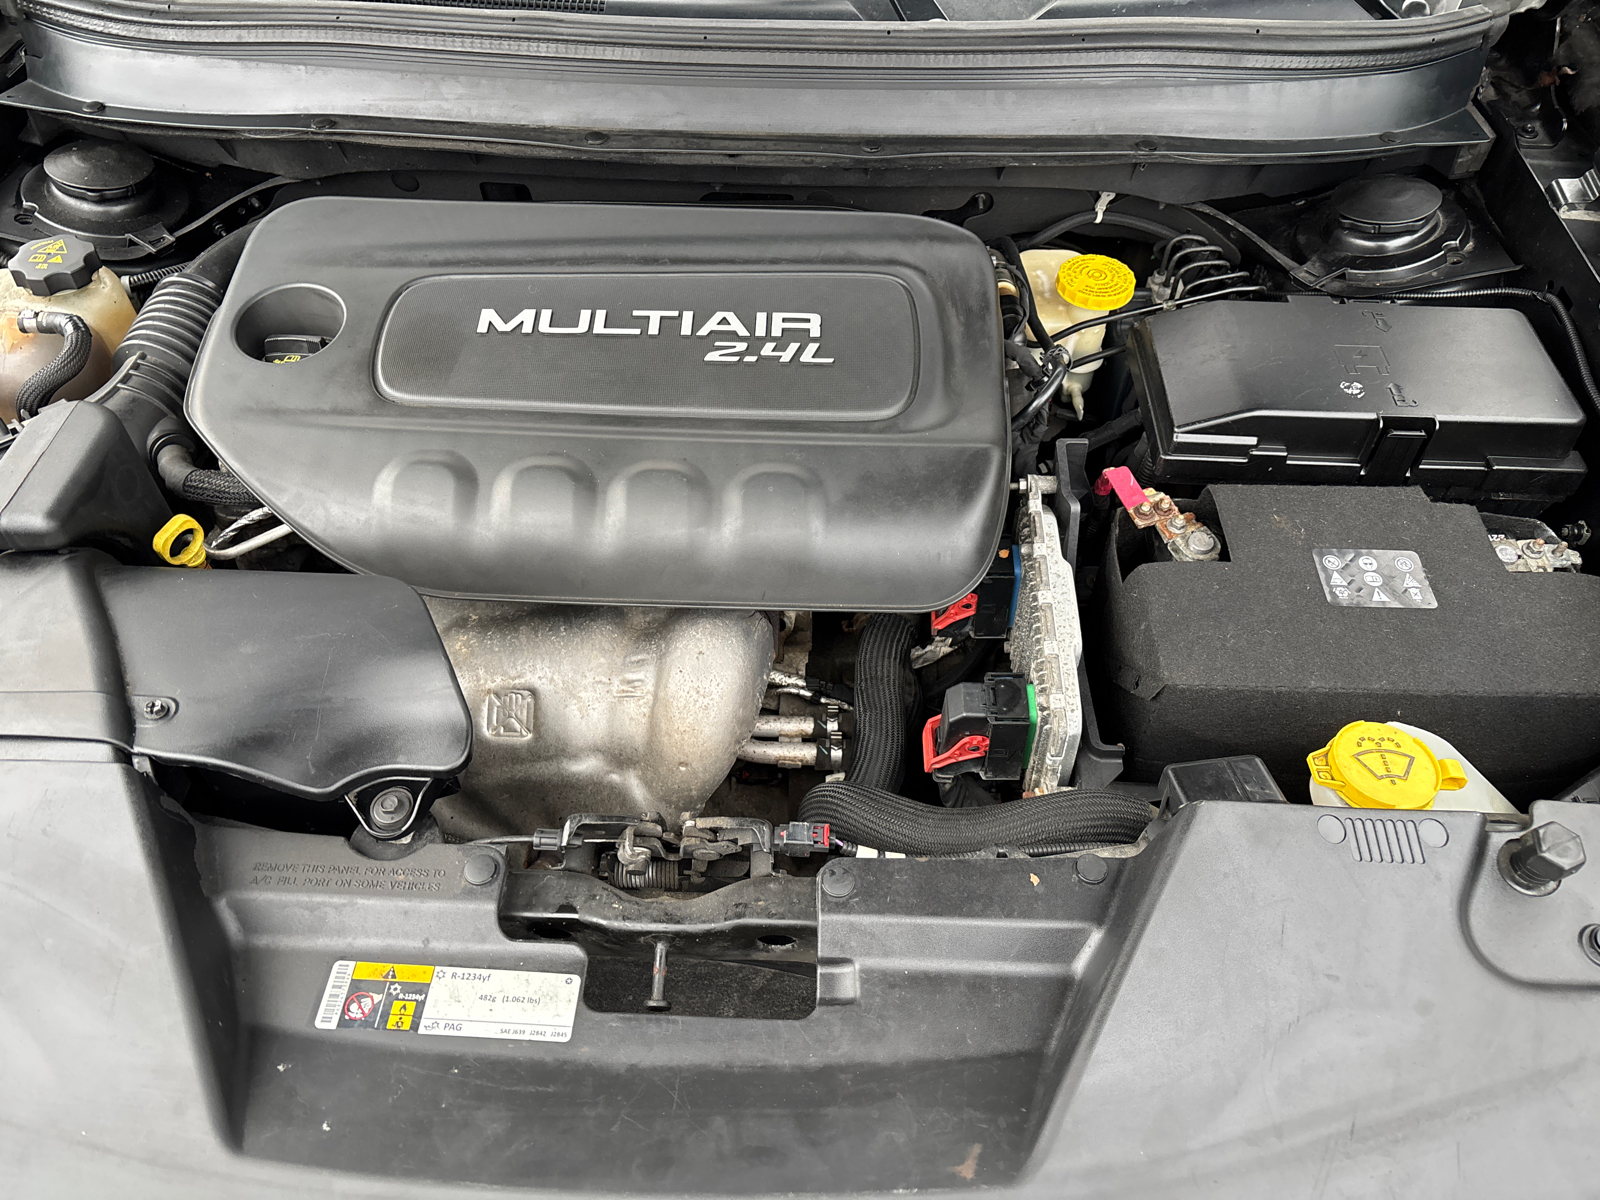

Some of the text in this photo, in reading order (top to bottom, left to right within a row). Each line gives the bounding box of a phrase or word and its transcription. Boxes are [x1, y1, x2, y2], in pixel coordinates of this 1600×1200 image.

[476, 308, 822, 338] MULTIAIR
[704, 341, 834, 363] 2.4L
[254, 862, 446, 878] REMOVE THIS PANEL FOR ACCESS TO
[250, 874, 441, 892] A/C FILL PORT ON SOME VEHICLES
[450, 971, 492, 983] R-1234yf
[478, 993, 541, 1006] 482g (1.062 lbs)
[443, 1022, 463, 1032] PAG
[550, 1031, 568, 1039] J2845
